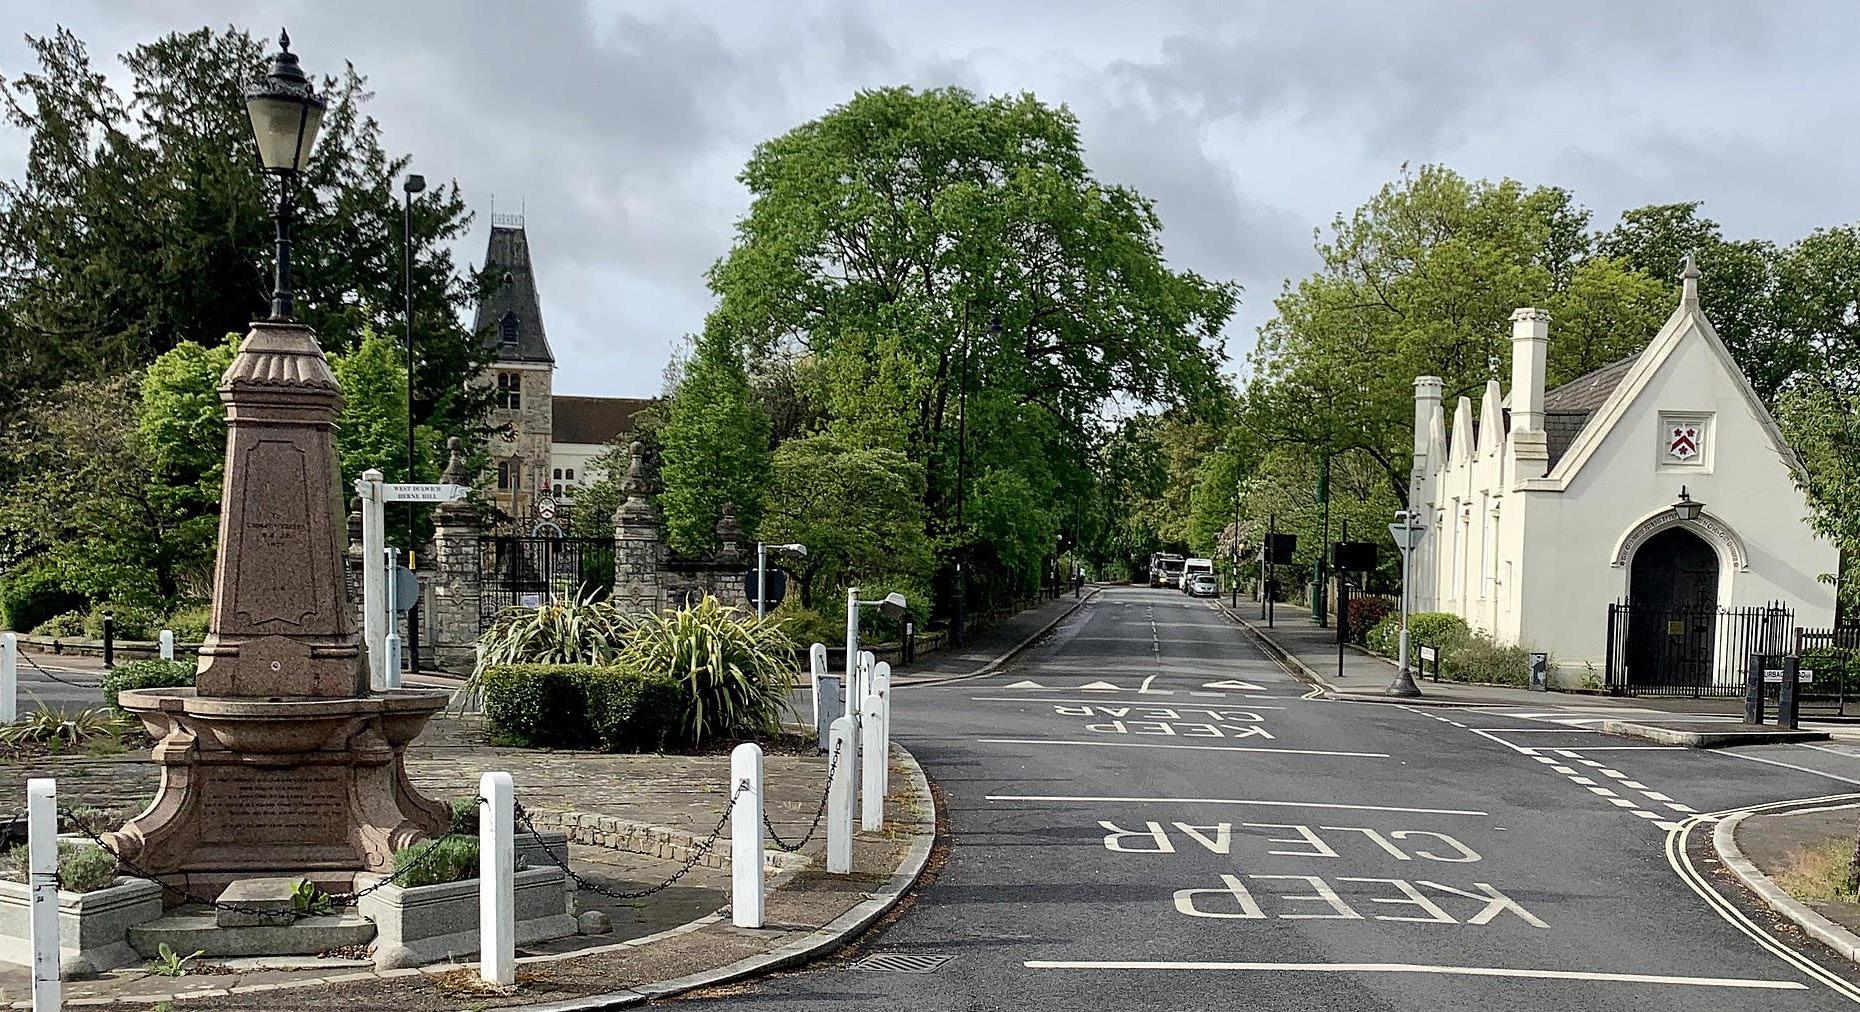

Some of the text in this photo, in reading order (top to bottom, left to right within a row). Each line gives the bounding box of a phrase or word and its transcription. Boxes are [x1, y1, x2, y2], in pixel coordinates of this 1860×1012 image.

[1053, 705, 1265, 722] CLEAR
[1085, 720, 1276, 739] KEEP
[1097, 820, 1482, 863] CLEAR
[1172, 874, 1551, 928] KEEP
